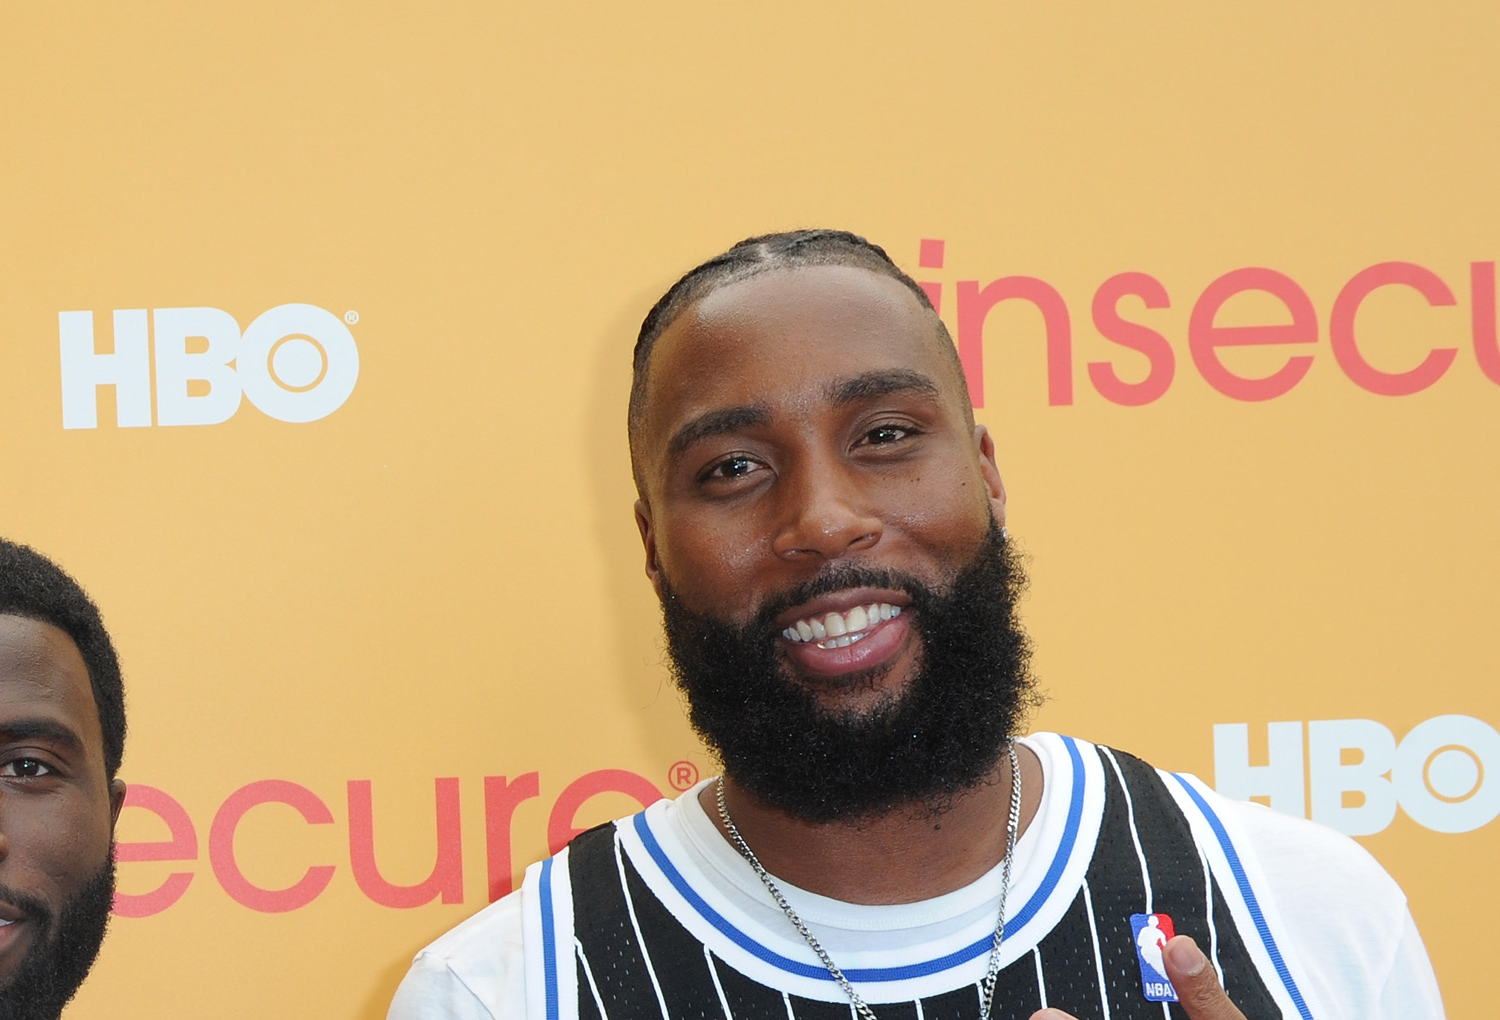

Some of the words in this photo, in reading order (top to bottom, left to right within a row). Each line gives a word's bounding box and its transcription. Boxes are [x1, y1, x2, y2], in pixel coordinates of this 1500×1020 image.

[915, 239, 1500, 408] nsec
[1213, 714, 1500, 836] HBO
[1145, 983, 1173, 997] NBA
